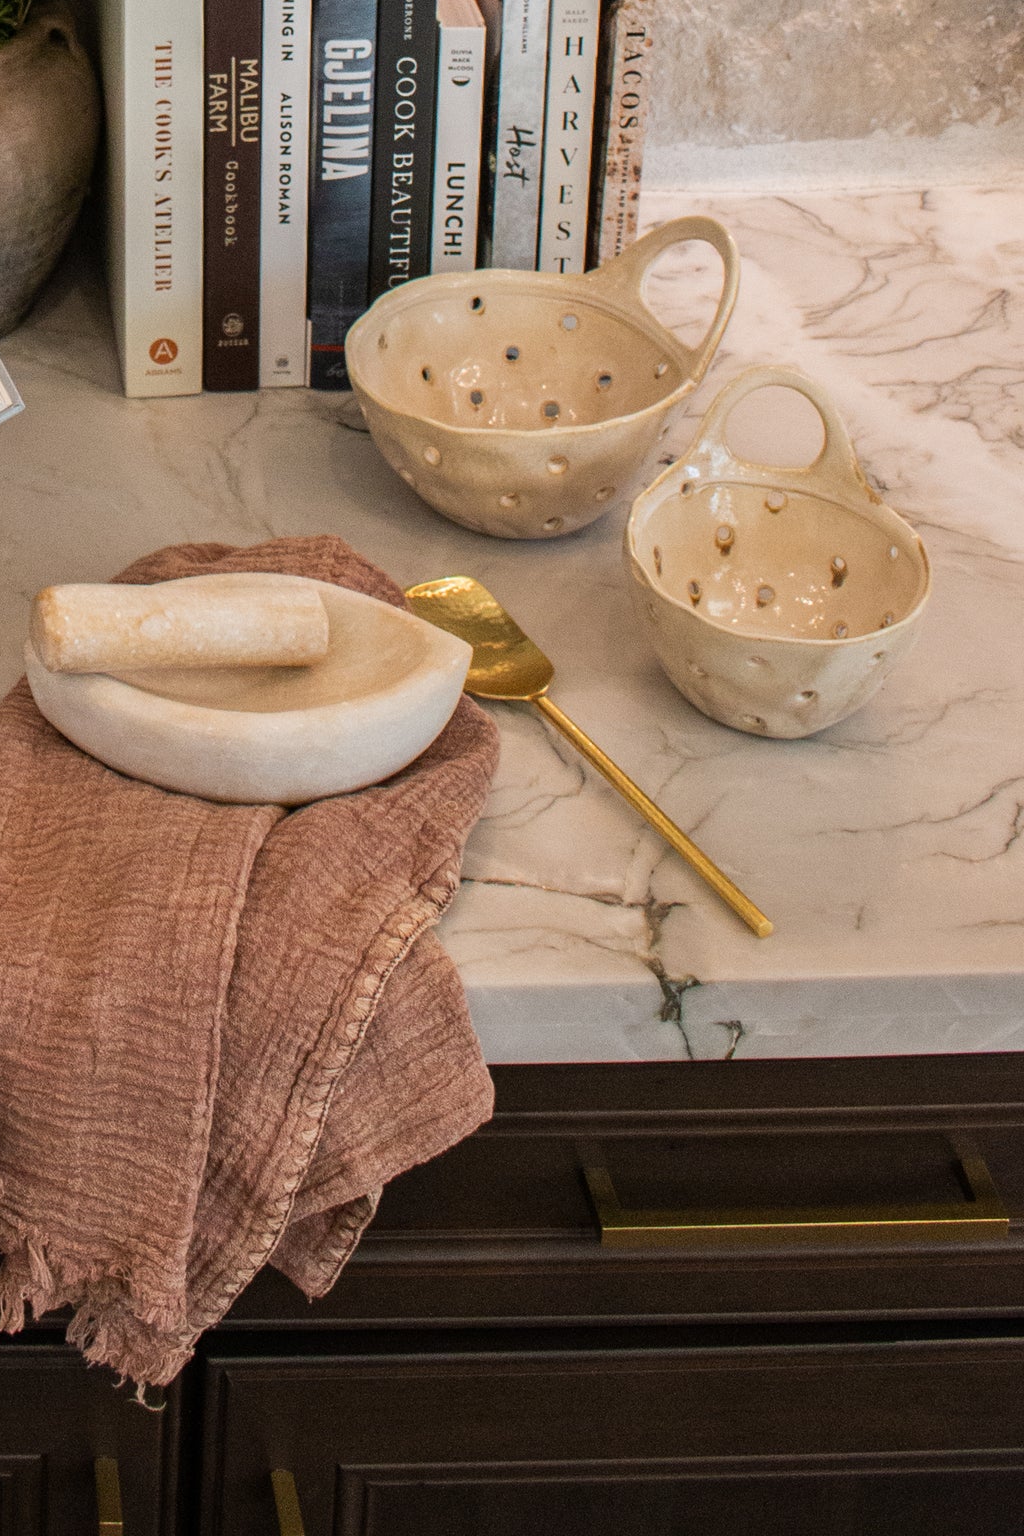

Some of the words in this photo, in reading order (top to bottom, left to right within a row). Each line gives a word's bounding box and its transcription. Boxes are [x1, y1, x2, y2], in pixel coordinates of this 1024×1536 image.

[155, 40, 172, 88] THE
[281, 44, 293, 61] IN
[619, 25, 646, 129] TACOS
[155, 99, 172, 182] COOK'S
[209, 74, 227, 132] FARM
[240, 59, 258, 143] MALIBU
[280, 92, 292, 155] ALISON
[322, 39, 373, 181] GJELINA
[394, 56, 417, 141] COOK
[278, 163, 291, 224] ROMAN
[503, 125, 537, 188] Host
[554, 36, 584, 273] HARVEST
[155, 193, 172, 291] ATELIER
[225, 160, 238, 246] Cookbook
[388, 153, 414, 288] BEAUTIFU
[444, 163, 465, 255] LUNCH!
[145, 368, 182, 376] ABRAMS
